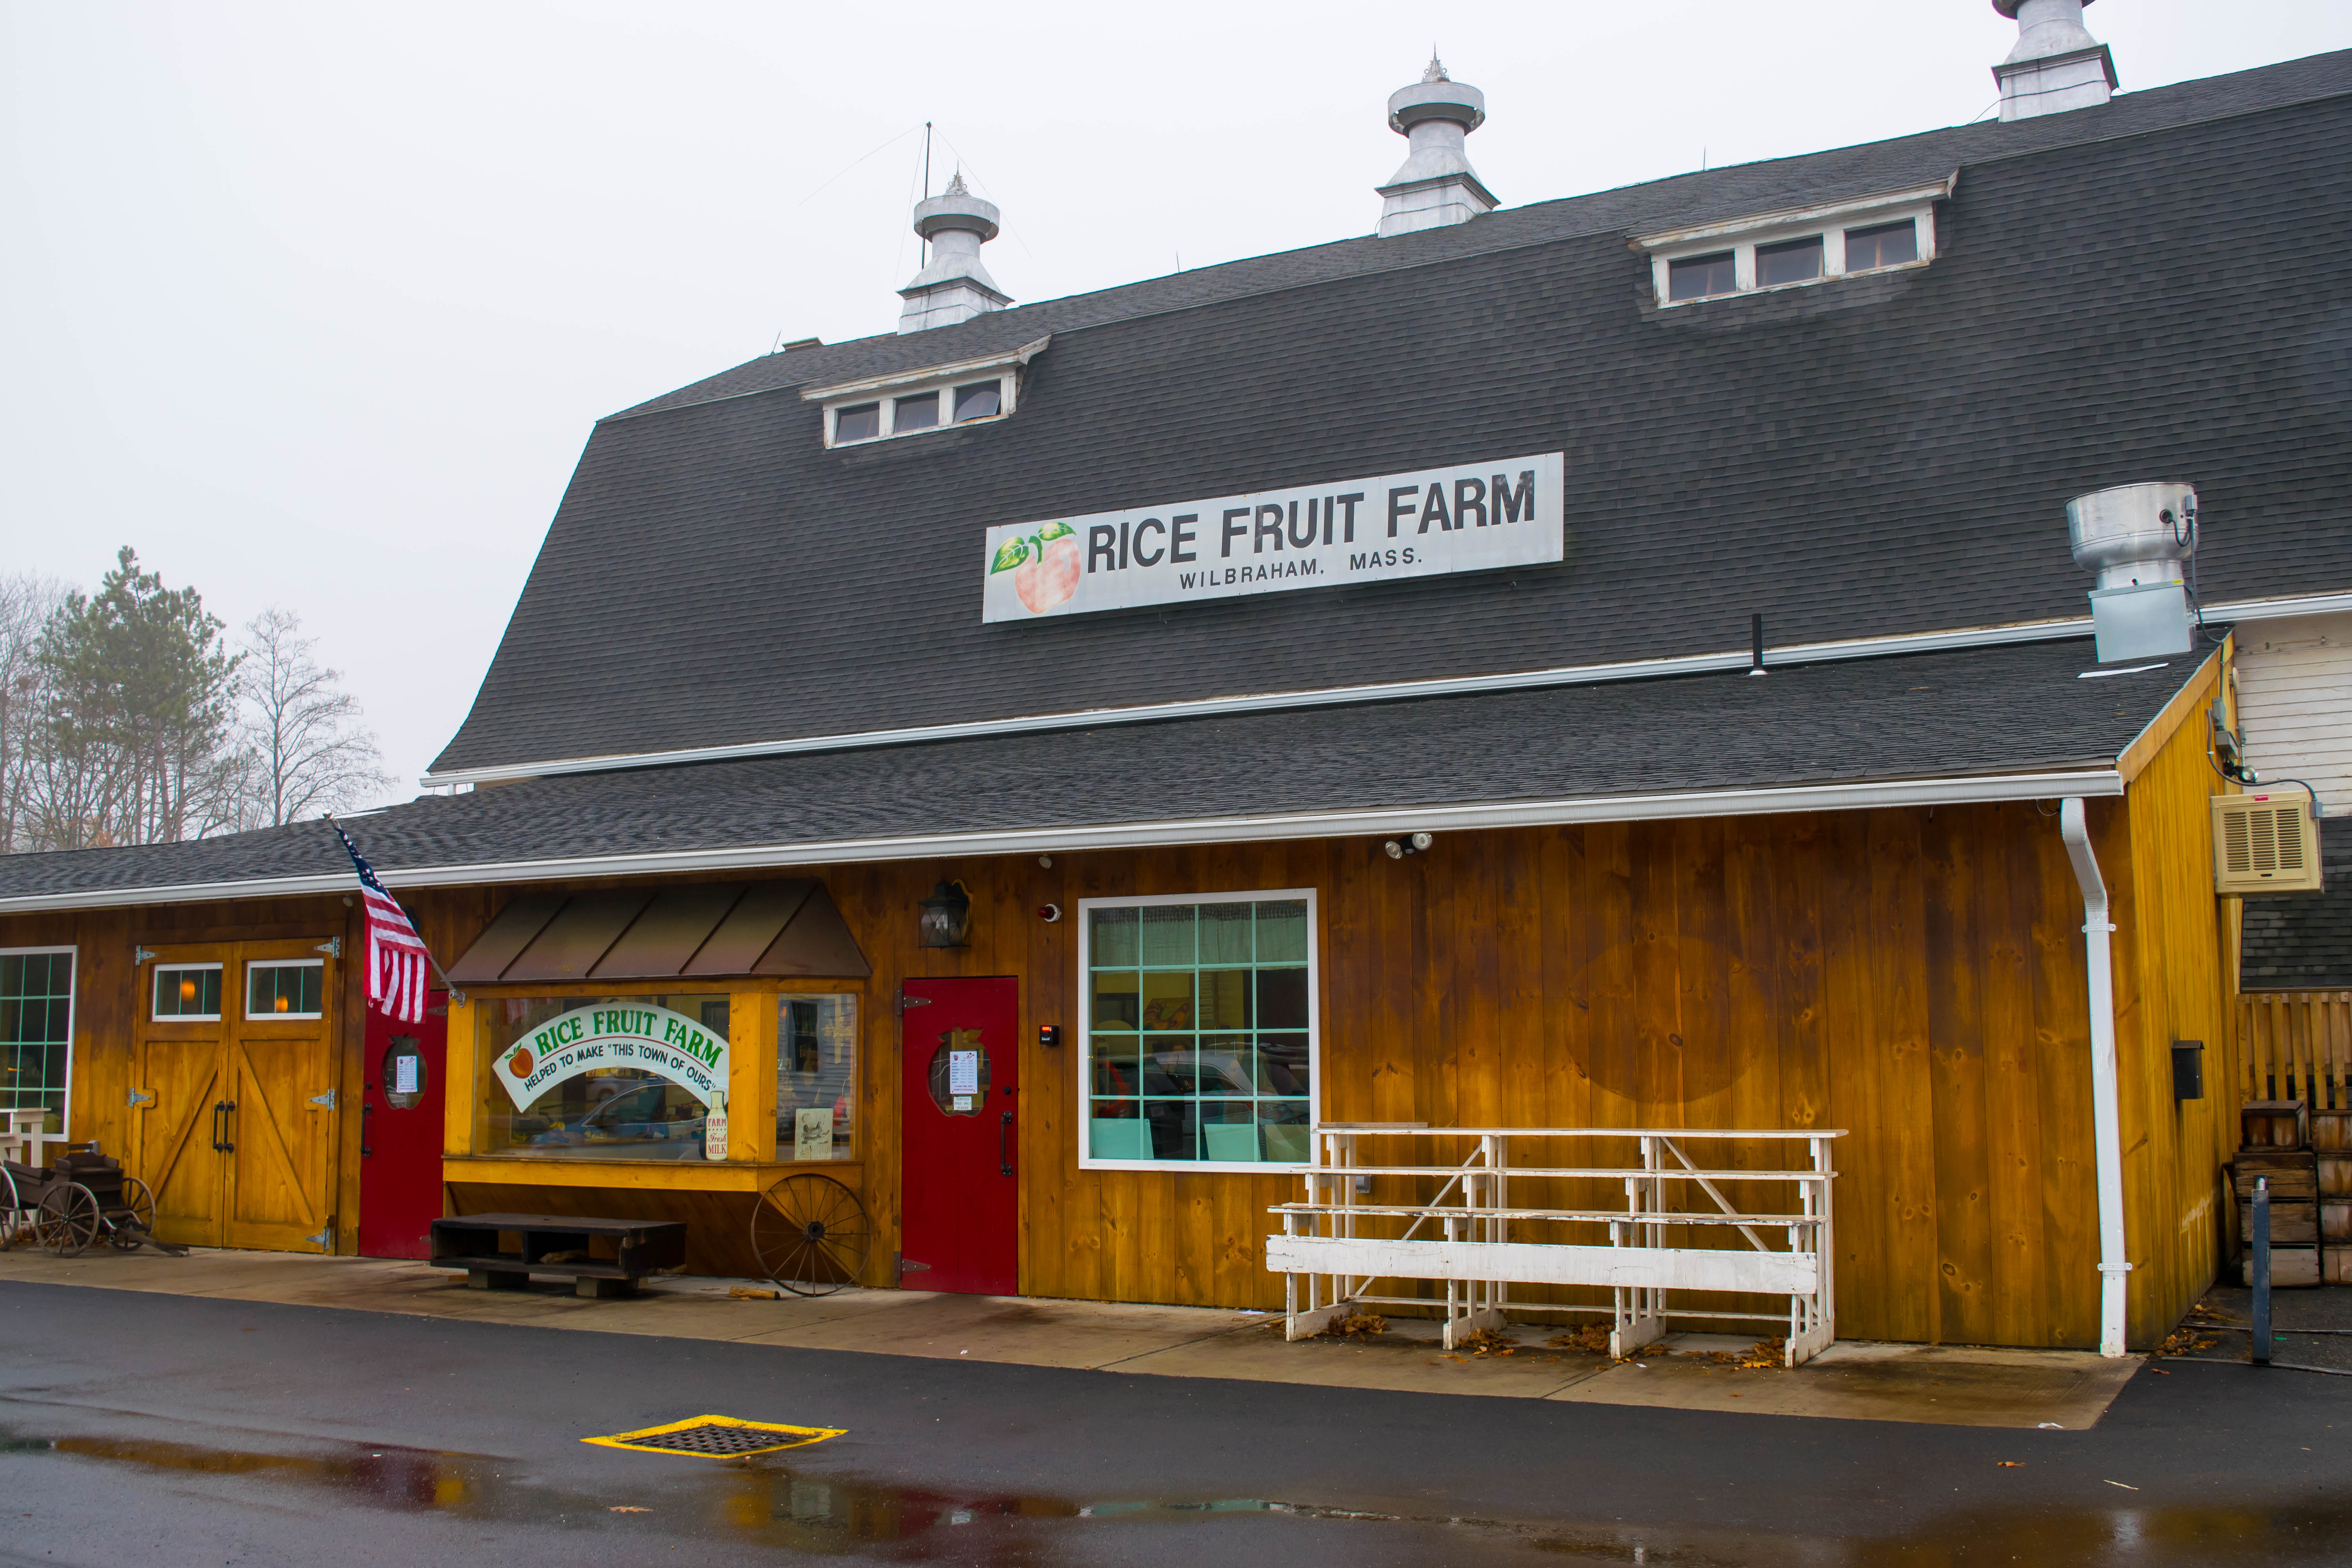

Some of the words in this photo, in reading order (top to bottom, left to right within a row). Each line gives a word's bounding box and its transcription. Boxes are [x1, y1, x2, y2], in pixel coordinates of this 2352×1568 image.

[1087, 514, 1198, 573] RICE
[1221, 492, 1365, 558] FRUIT
[1387, 470, 1535, 538] FARM
[1180, 559, 1324, 590] WILBRAHAM,
[1350, 548, 1422, 570] MASS.
[535, 1016, 584, 1056] RICE
[593, 1010, 657, 1036] FRUIT
[664, 1018, 723, 1069] FARM
[524, 1062, 557, 1092] HELPED
[559, 1054, 573, 1067] TO
[577, 1045, 604, 1062] MAKE
[639, 1045, 668, 1064] TOWN
[671, 1057, 685, 1071] OF
[708, 1118, 726, 1127] FARM
[708, 1133, 726, 1142] Fresh
[708, 1143, 726, 1154] MILK
